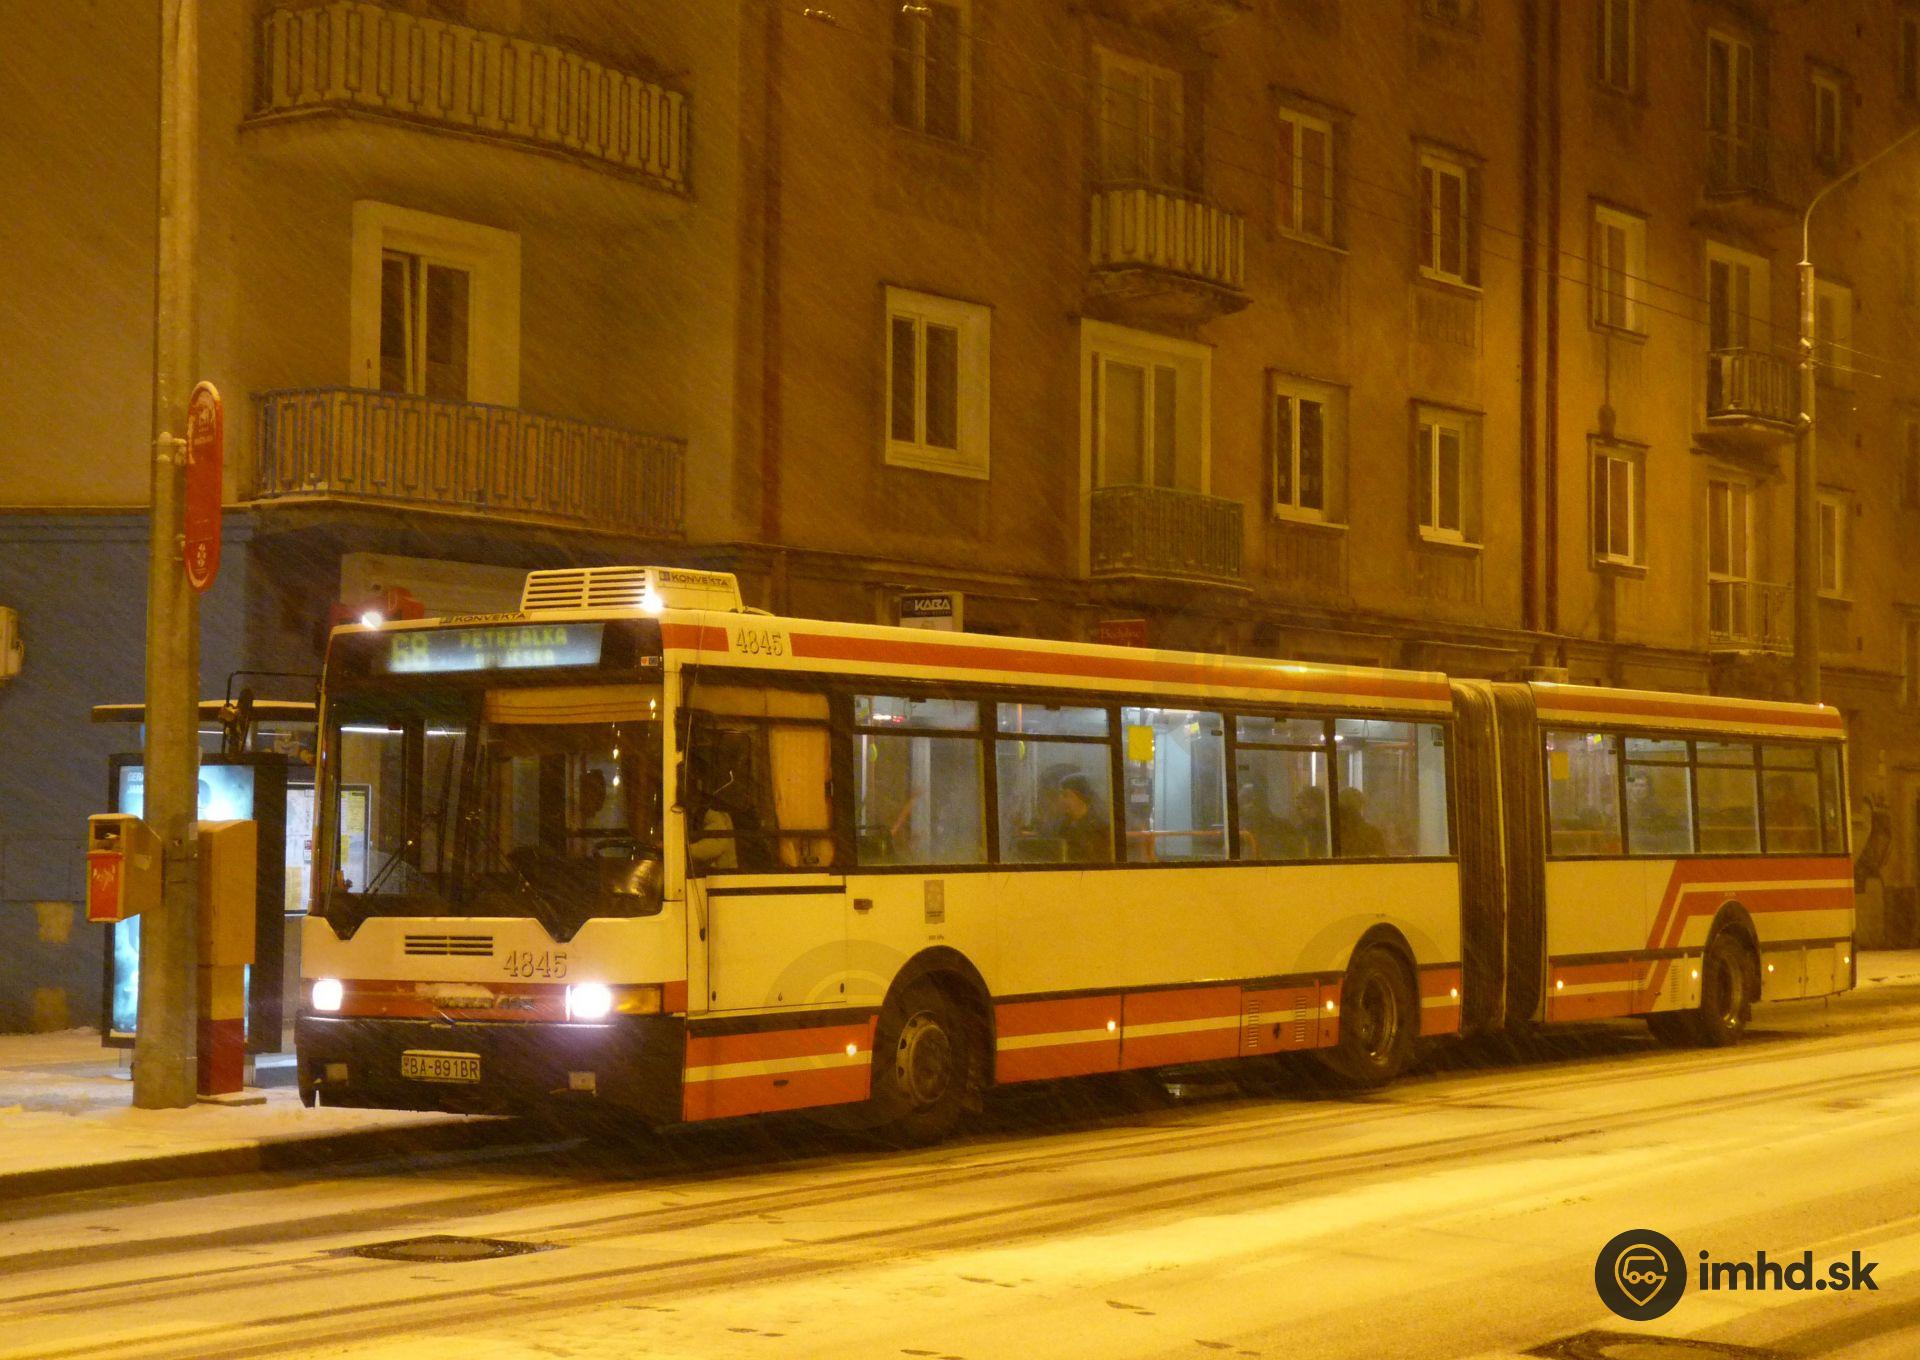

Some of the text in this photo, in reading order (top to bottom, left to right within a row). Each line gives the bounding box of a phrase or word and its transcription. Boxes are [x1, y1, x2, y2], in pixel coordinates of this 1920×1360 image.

[735, 627, 784, 656] 4845
[503, 950, 567, 978] 4845
[410, 1057, 478, 1078] BA-891BR
